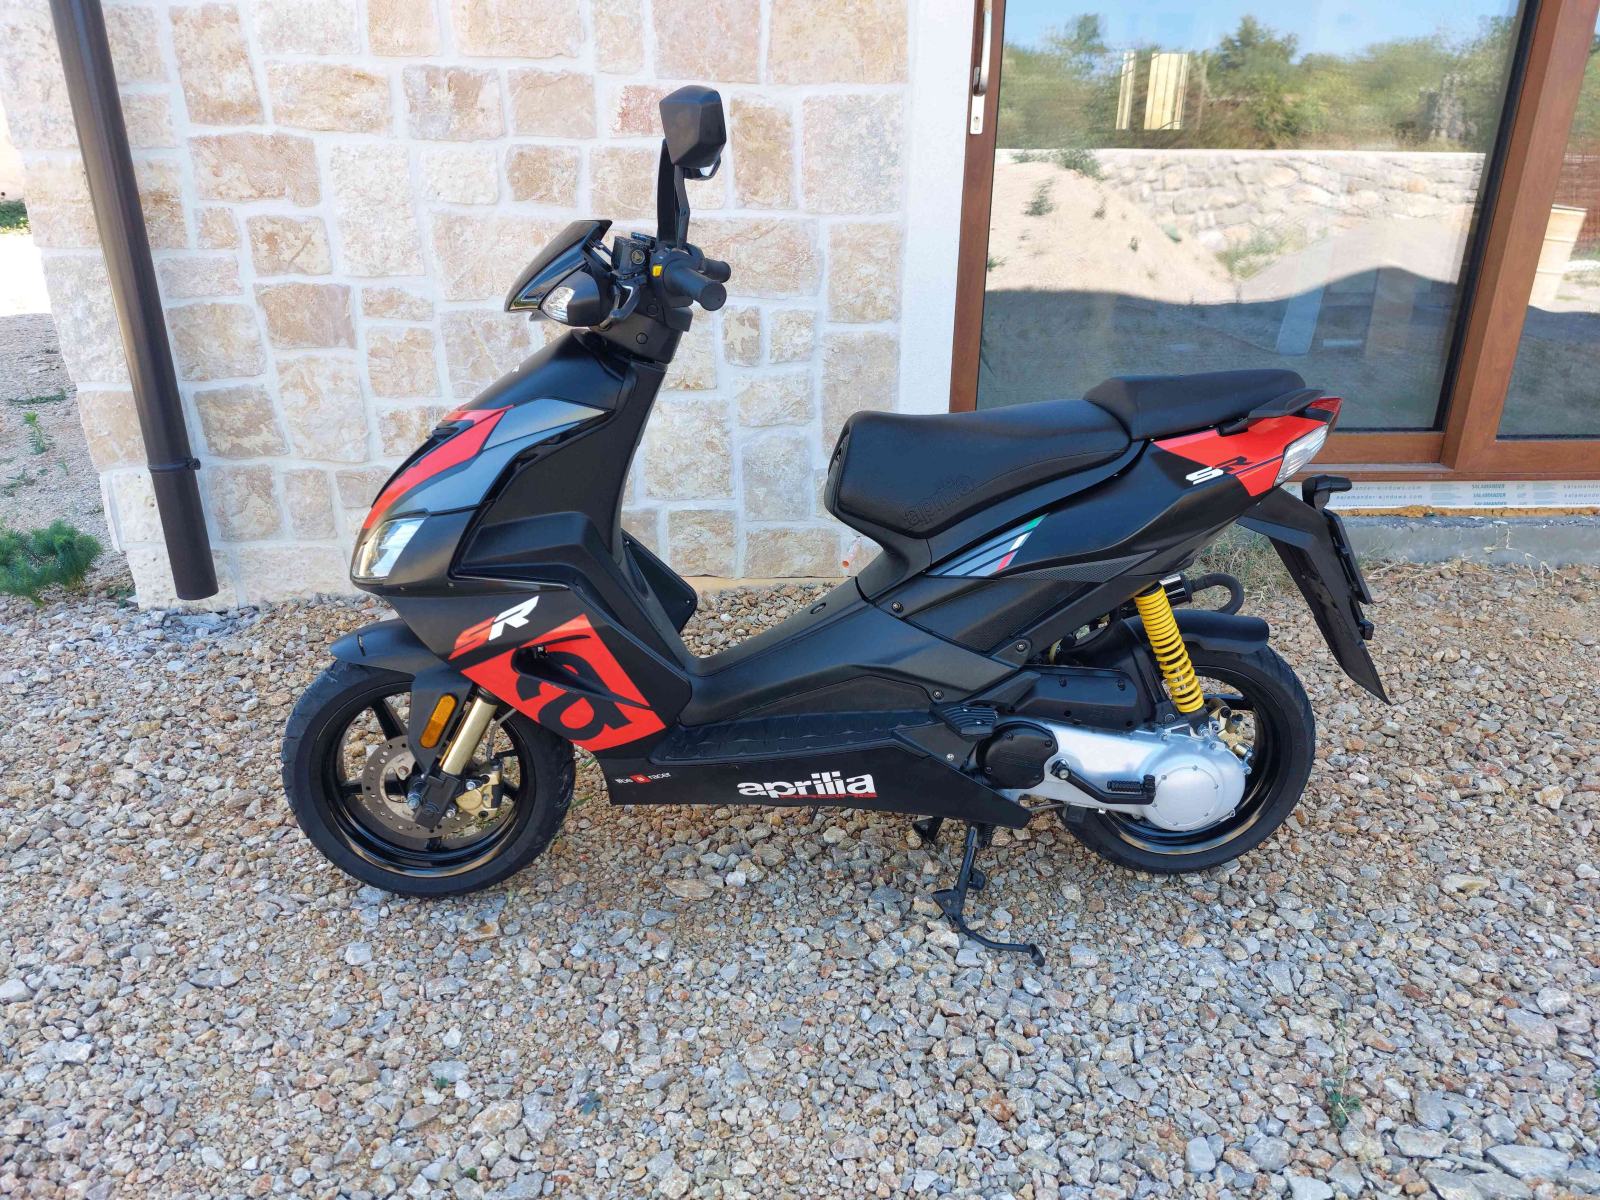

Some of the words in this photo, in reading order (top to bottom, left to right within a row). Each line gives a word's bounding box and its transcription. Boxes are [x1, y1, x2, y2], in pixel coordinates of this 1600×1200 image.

[1186, 456, 1253, 485] SR
[448, 596, 539, 660] SR
[737, 770, 876, 799] aprilia
